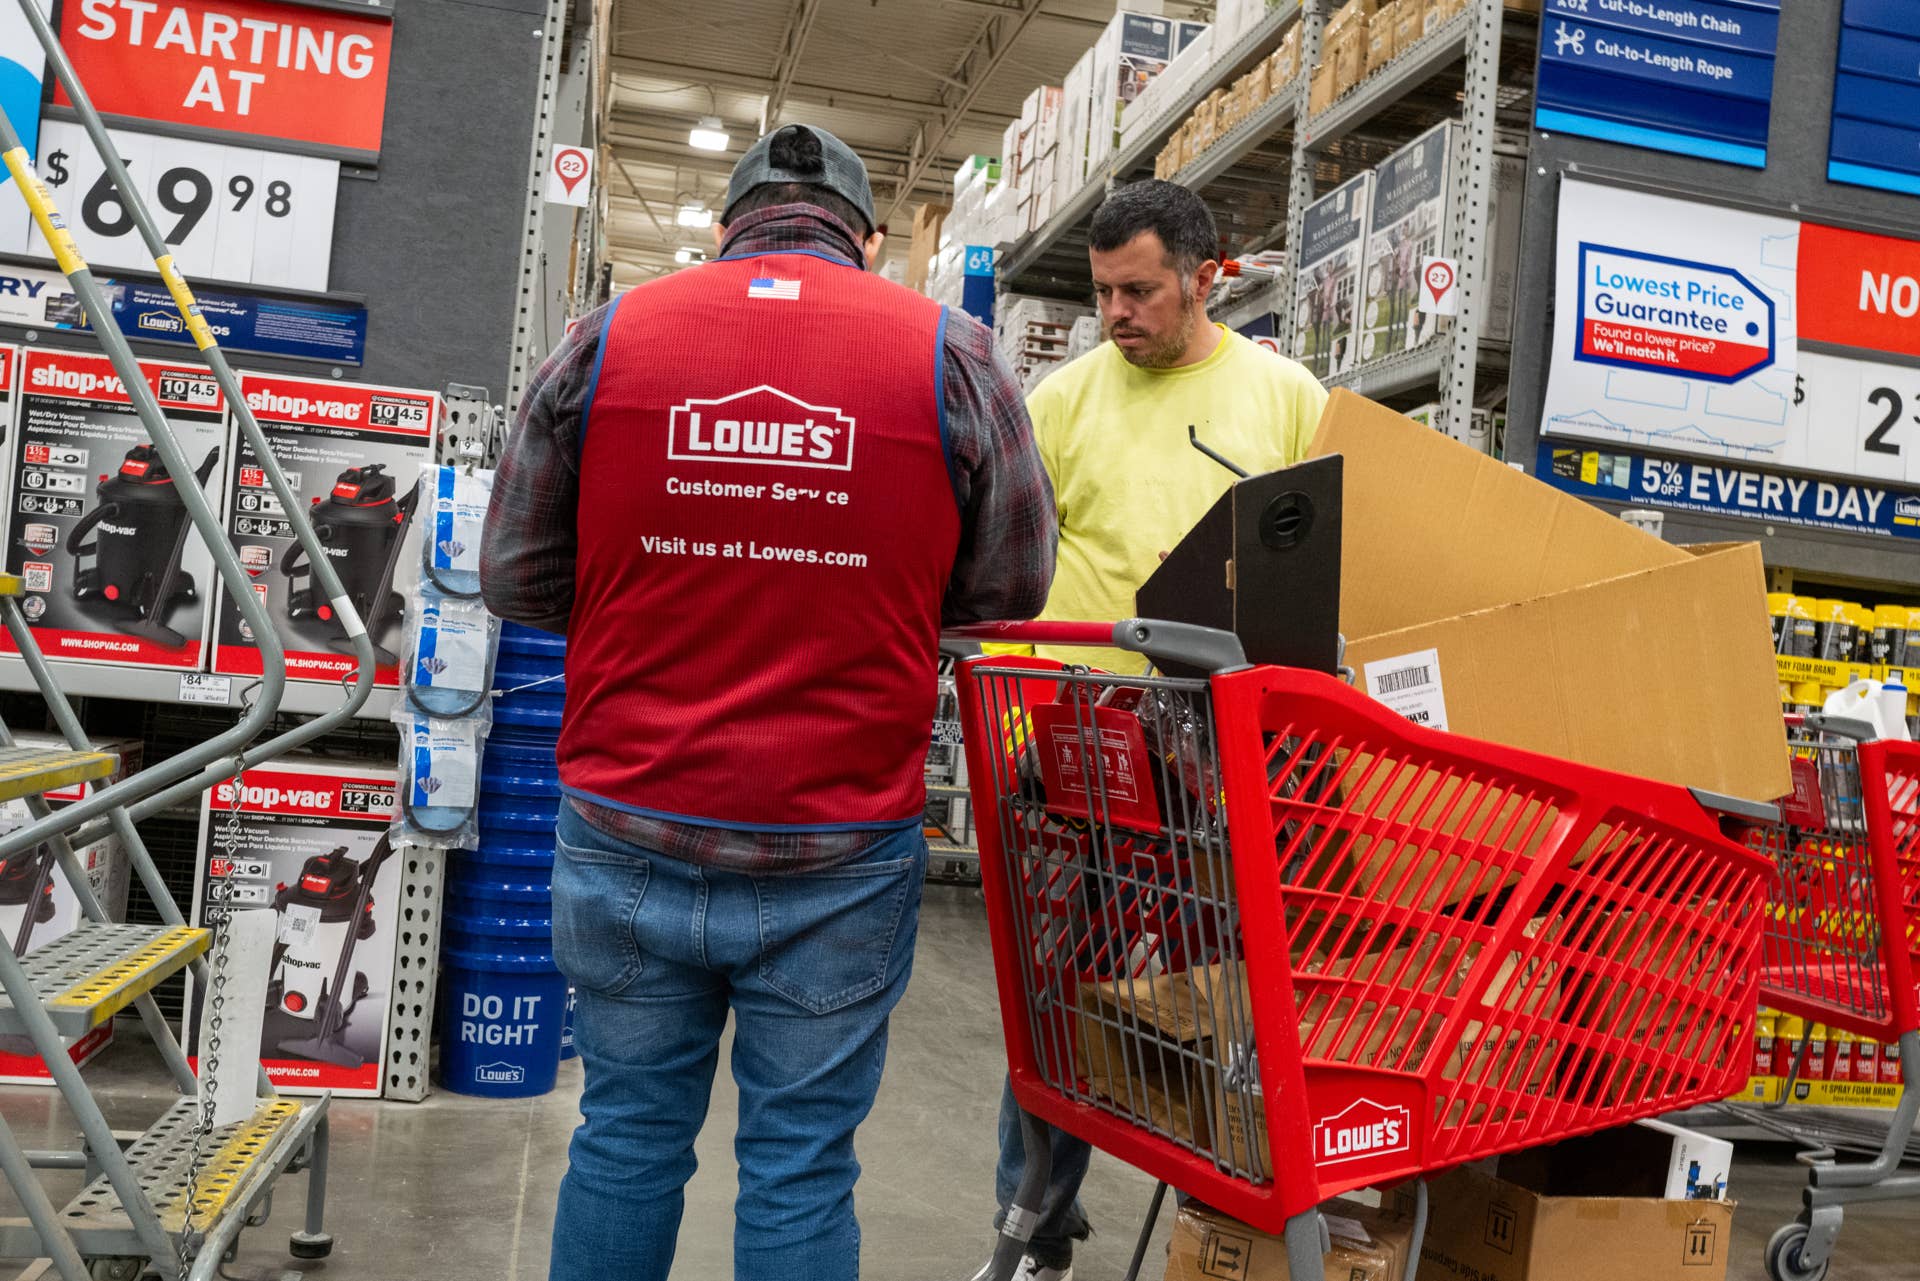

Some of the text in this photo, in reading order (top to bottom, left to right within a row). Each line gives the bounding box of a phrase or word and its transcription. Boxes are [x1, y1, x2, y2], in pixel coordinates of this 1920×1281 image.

[1600, 0, 1742, 36] Cut-to-Length Chain
[77, 0, 375, 80] STARTING
[1595, 38, 1733, 80] Cut-to-Length Rope
[183, 66, 265, 116] AT
[562, 160, 580, 172] 22
[228, 174, 292, 218] 98
[1432, 271, 1447, 283] 27
[1595, 264, 1744, 312] Lowest Price
[143, 315, 179, 330] LOWE'S
[1594, 293, 1728, 333] Guarantee
[1593, 323, 1716, 355] Found a lower price?
[1593, 337, 1679, 363] We'll match it.
[164, 380, 186, 394] 10
[190, 383, 216, 397] 4.5
[59, 411, 86, 421] Vacuum
[375, 405, 396, 419] 10
[400, 407, 423, 421] 4.5
[1863, 386, 1903, 457] 2
[688, 411, 834, 460] LOWE'S
[665, 476, 849, 505] Customer Servce
[1641, 458, 1684, 493] 5%
[1689, 466, 1808, 514] EVERY
[1815, 486, 1886, 525] DAY
[640, 535, 868, 568] Visit us at Lowes.com
[61, 637, 140, 653] WWW.SHOPVAC.COM
[284, 658, 353, 672] WW.SHOPVAC.COM
[1814, 664, 1837, 676] BRAND
[186, 674, 201, 686] 84
[344, 791, 366, 805] 12
[370, 793, 394, 807] 6.0
[243, 827, 269, 835] Vacuum
[462, 991, 503, 1020] DO
[512, 994, 542, 1020] IT
[460, 1020, 539, 1046] RIGHT
[480, 1068, 520, 1081] LOWE'S
[1829, 1085, 1851, 1095] SPRAY
[1852, 1086, 1872, 1095] FOAM
[1873, 1087, 1896, 1097] BRAND
[1324, 1117, 1401, 1157] LOWE'S
